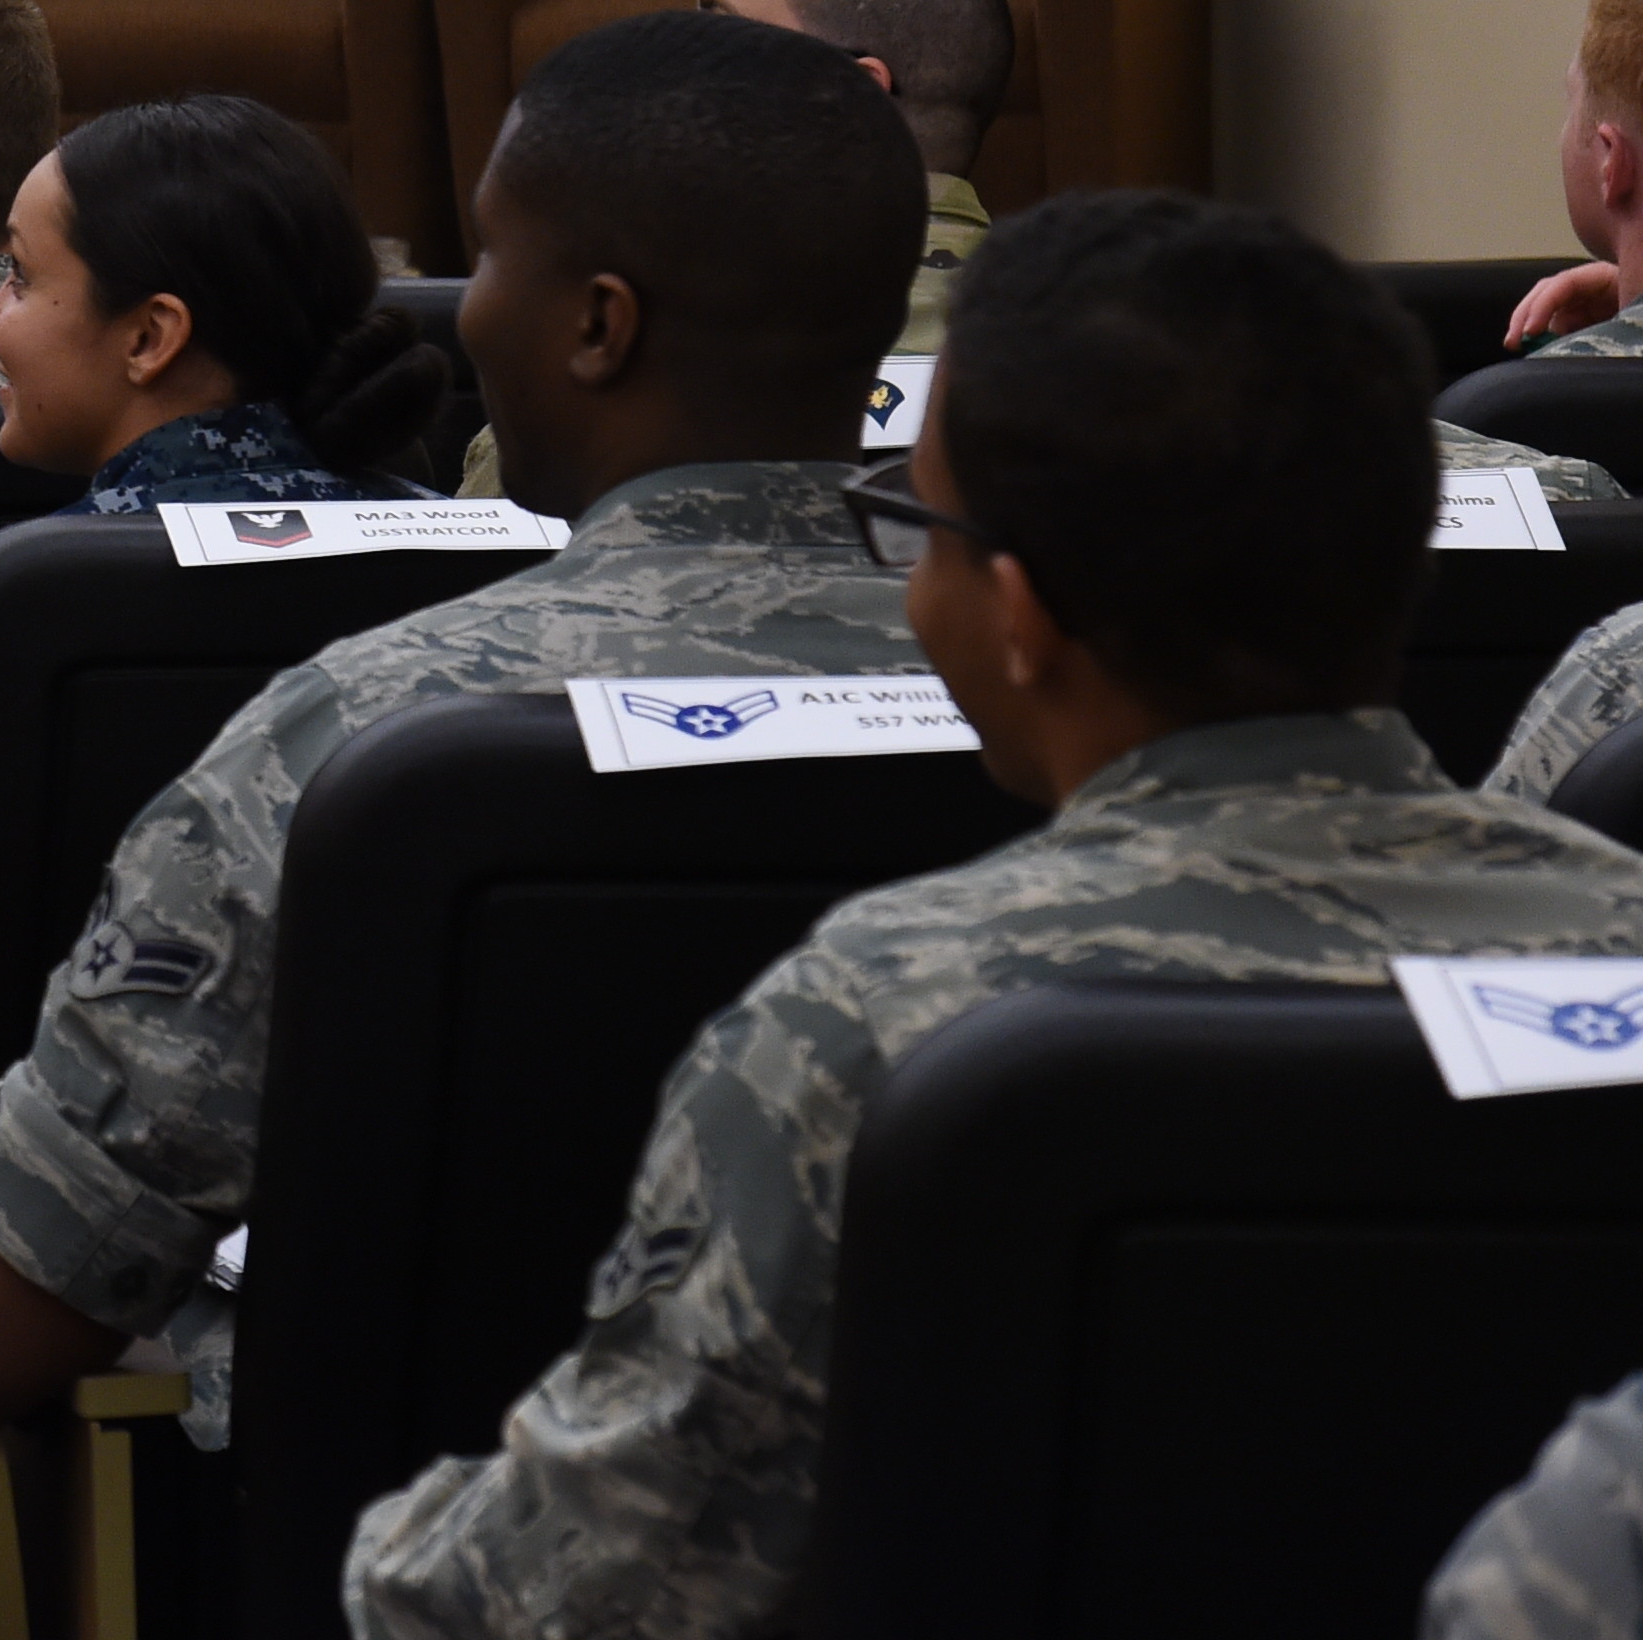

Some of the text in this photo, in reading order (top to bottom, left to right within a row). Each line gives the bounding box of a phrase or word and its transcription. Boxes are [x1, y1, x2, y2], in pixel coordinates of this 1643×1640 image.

[355, 510, 500, 521] MA3 Wood
[361, 526, 511, 537] USSTRATCOM
[800, 691, 862, 704] A1C
[858, 716, 904, 729] 557
